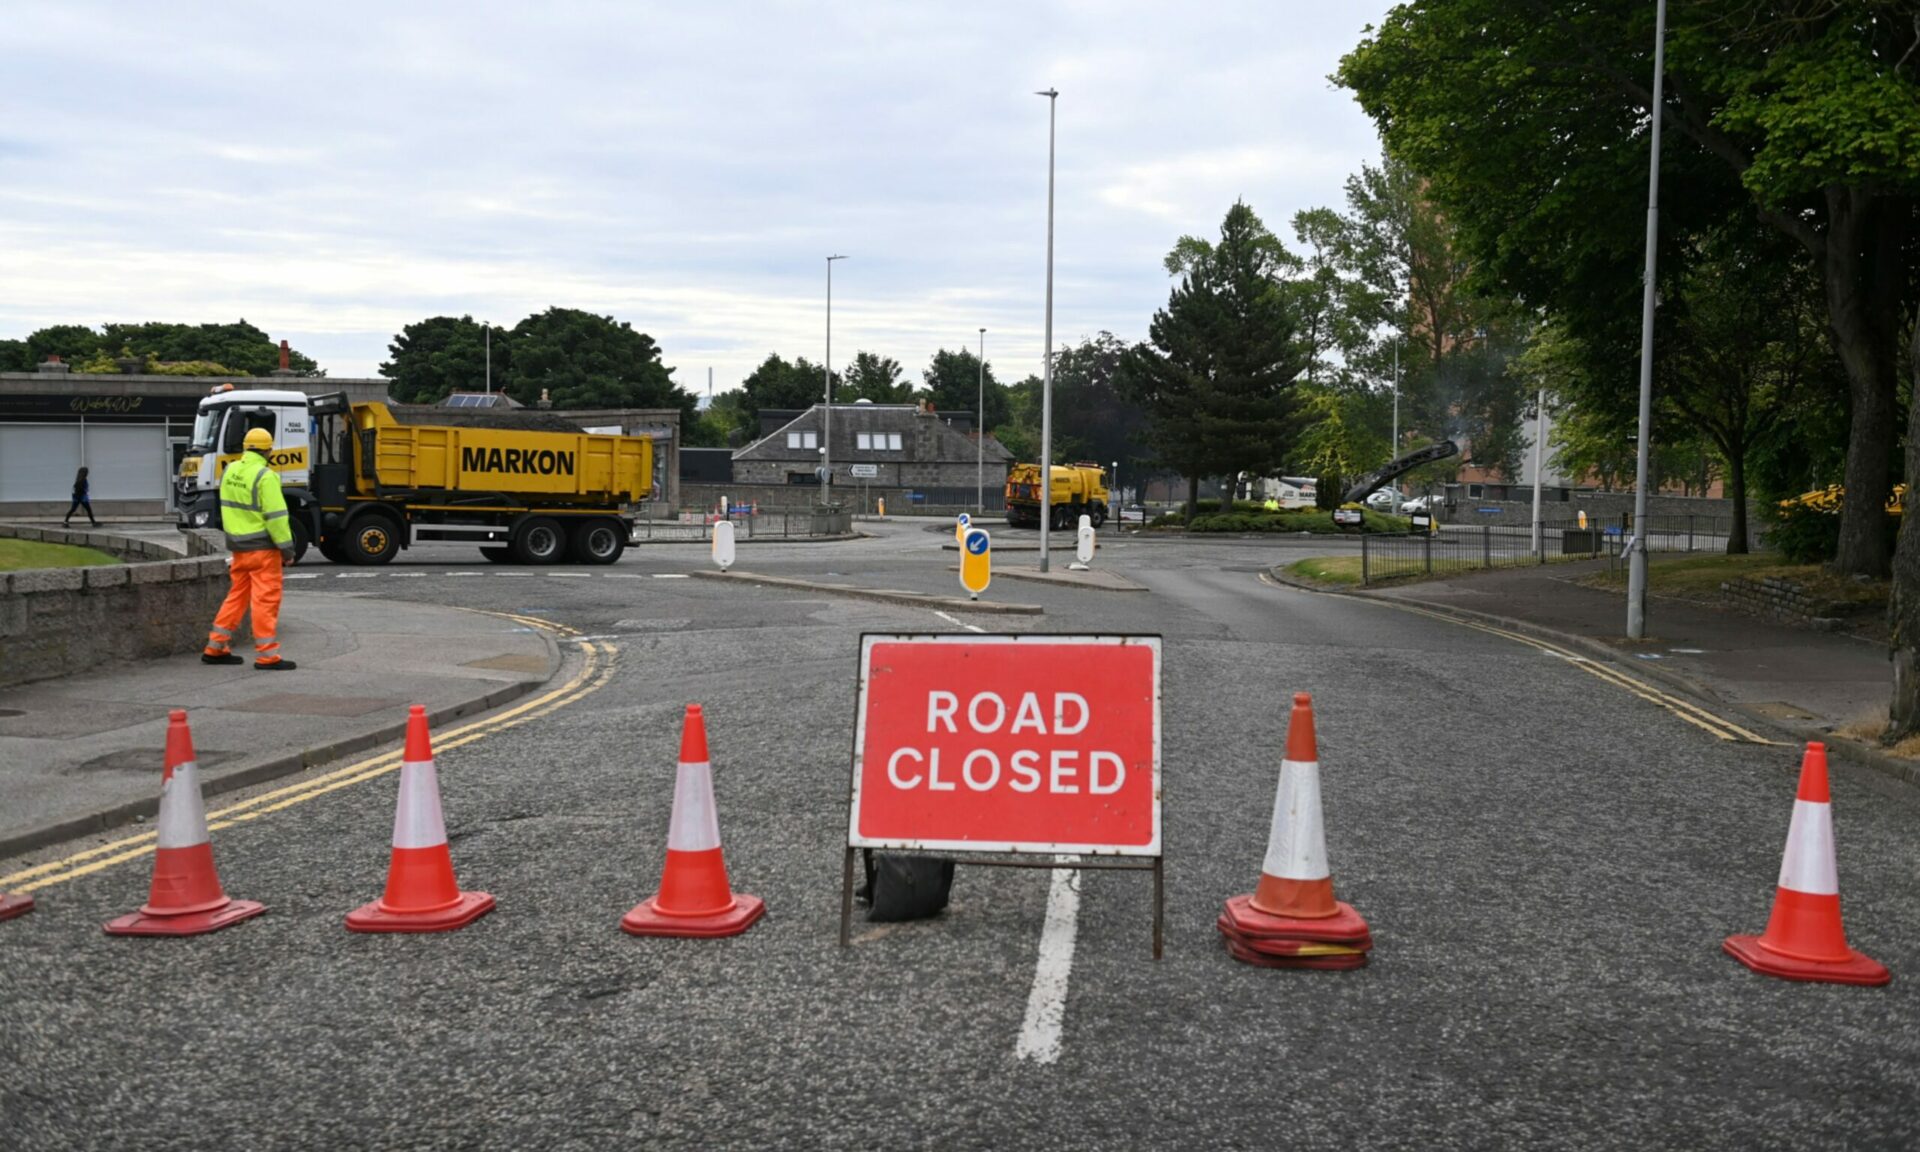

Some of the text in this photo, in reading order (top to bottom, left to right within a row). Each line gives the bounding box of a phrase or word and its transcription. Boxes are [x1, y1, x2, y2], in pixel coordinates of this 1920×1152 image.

[462, 447, 574, 476] MARKON
[927, 690, 1090, 735] ROAD
[887, 747, 1126, 795] CLOSED
